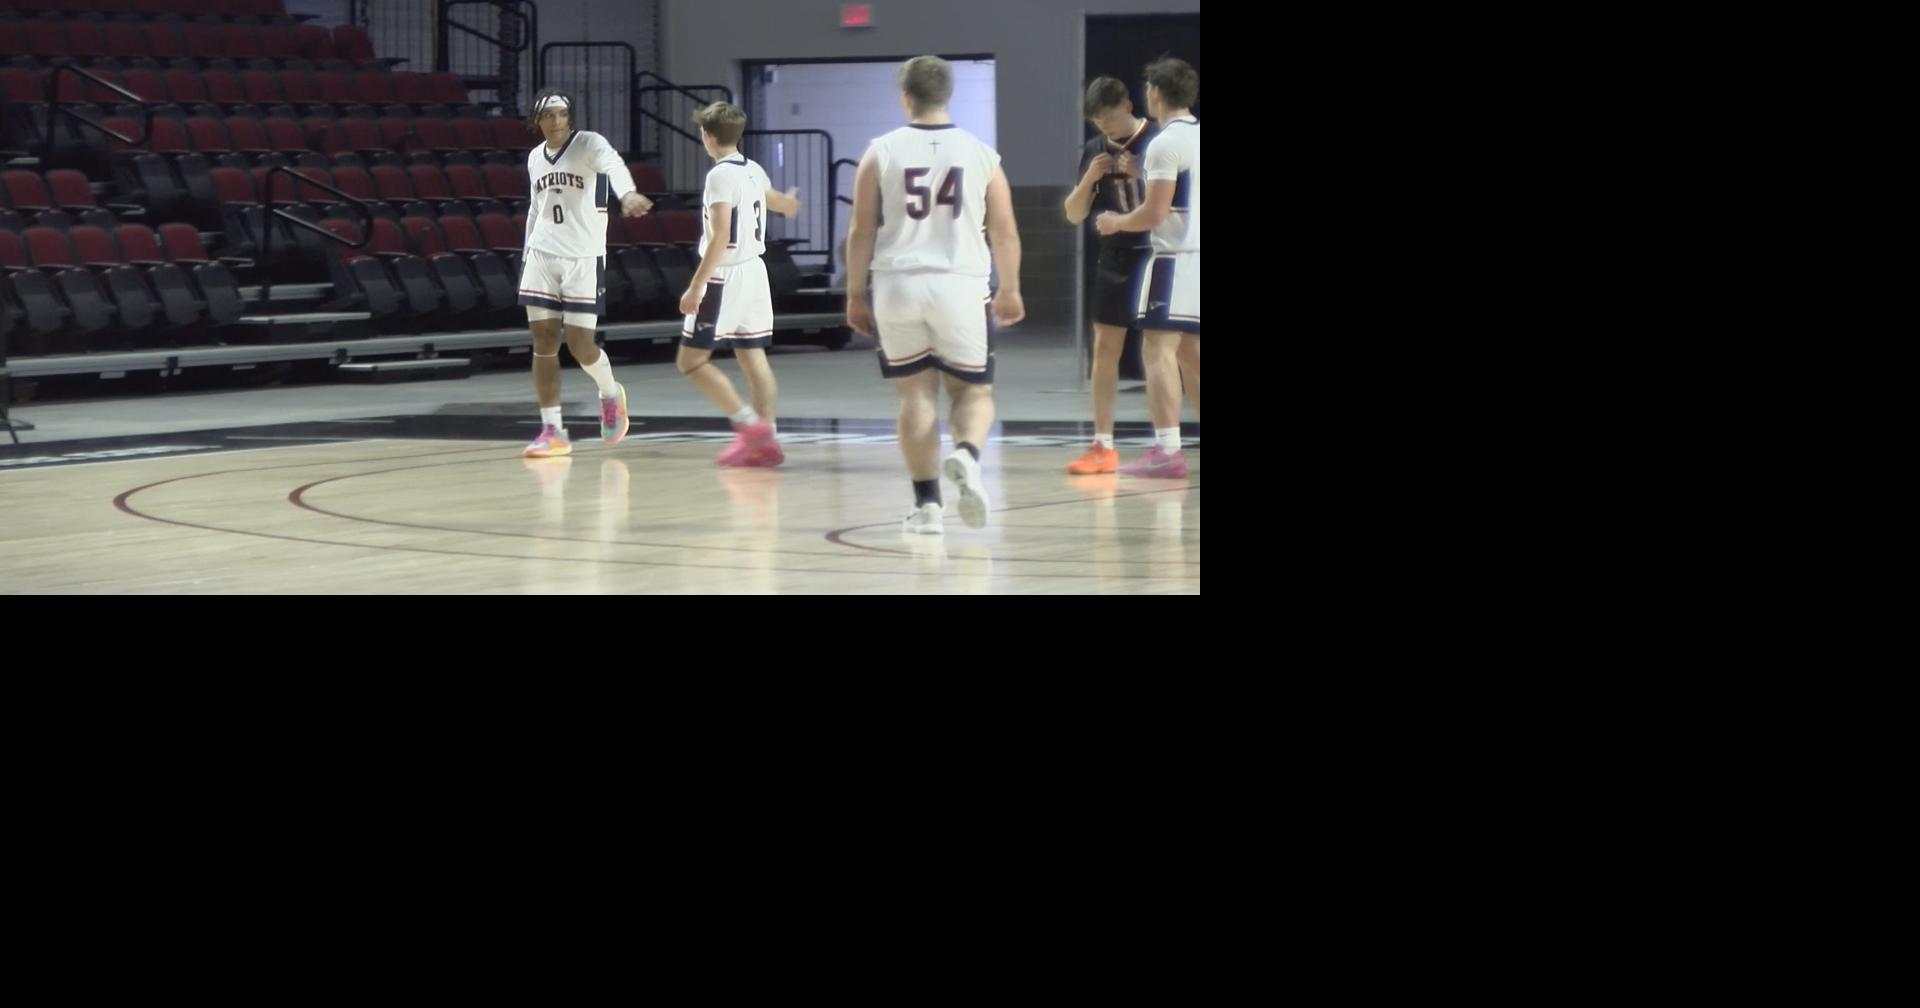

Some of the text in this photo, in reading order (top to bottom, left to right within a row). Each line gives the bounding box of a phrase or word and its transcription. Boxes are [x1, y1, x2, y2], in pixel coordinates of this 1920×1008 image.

[535, 171, 584, 194] ATRIOTS
[904, 166, 964, 221] 54
[552, 204, 564, 225] 0
